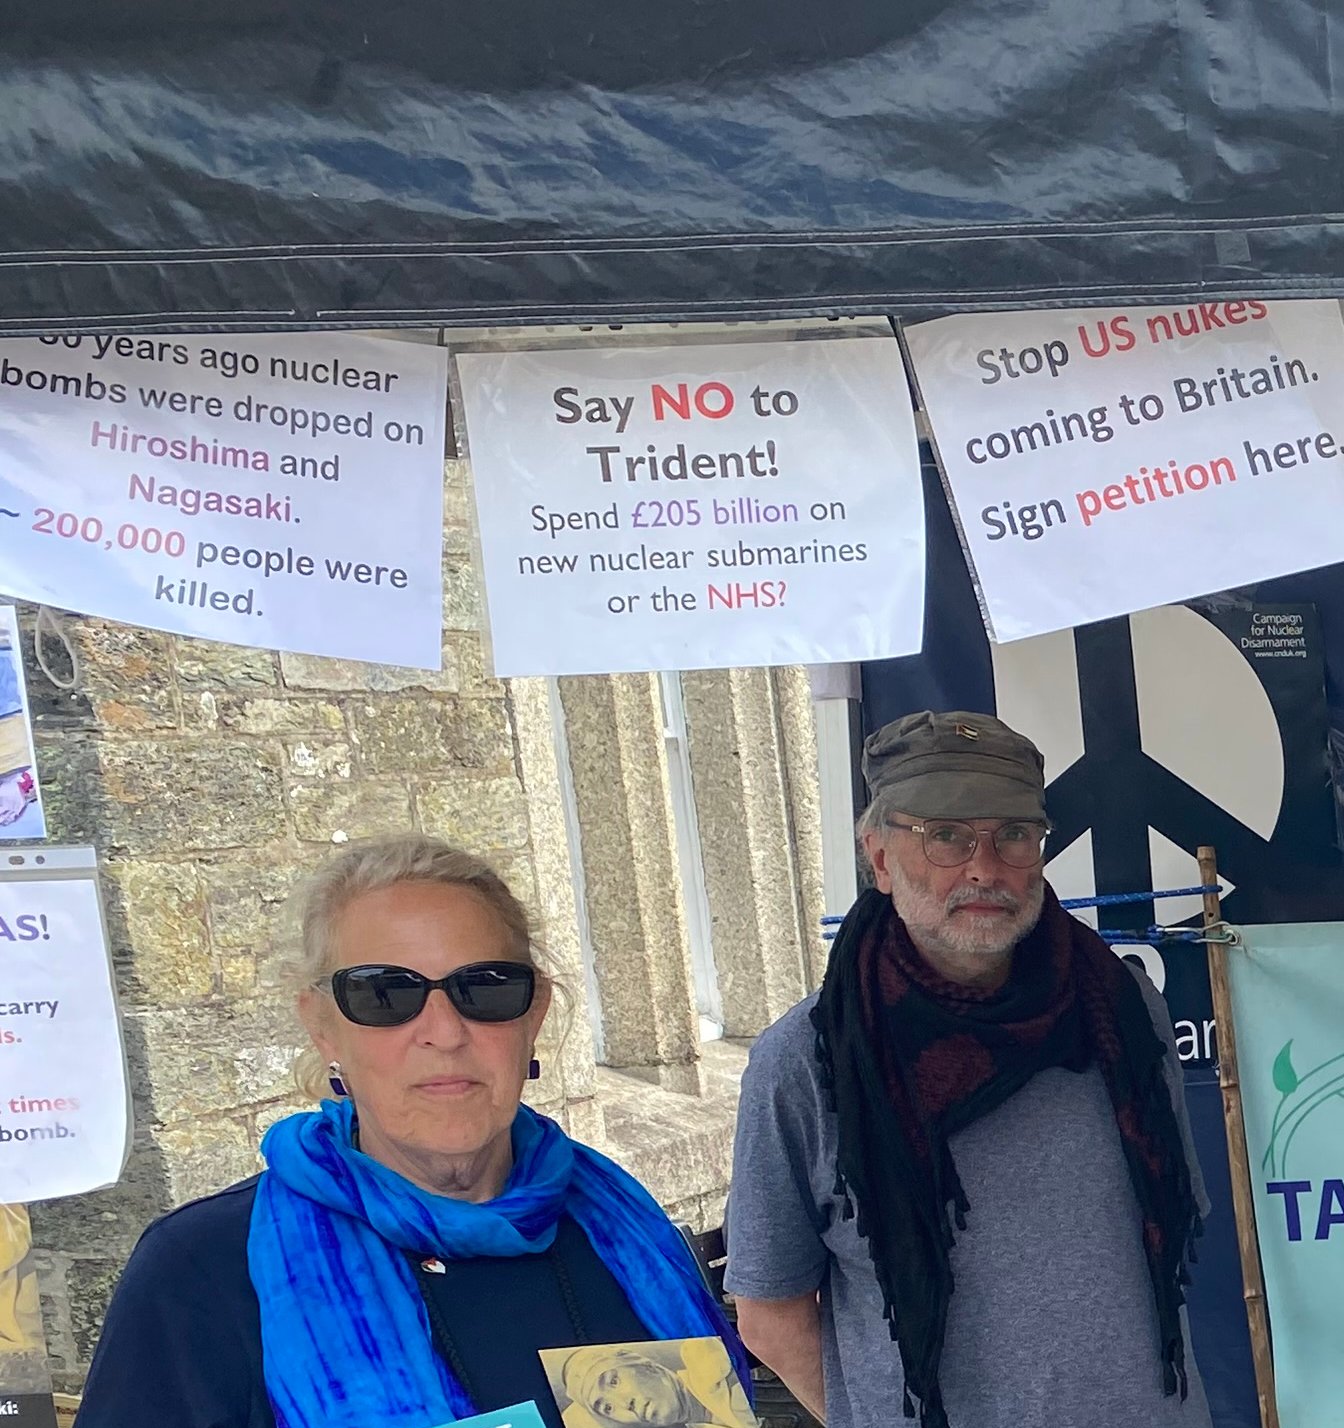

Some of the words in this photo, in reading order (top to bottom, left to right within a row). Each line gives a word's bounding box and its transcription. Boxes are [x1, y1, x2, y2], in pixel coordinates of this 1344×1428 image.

[93, 336, 189, 366] years
[199, 348, 260, 379] ago
[270, 356, 399, 393] nuclear
[976, 339, 1069, 385] Stop
[1077, 315, 1136, 358] US
[1146, 300, 1268, 343] nukes
[0, 357, 127, 404] bombs
[138, 387, 223, 418] were
[233, 394, 373, 439] dropped
[383, 421, 424, 446] on
[553, 386, 635, 434] Say
[651, 381, 735, 421] NO
[749, 384, 799, 418] to
[966, 405, 1114, 465] coming
[1118, 394, 1164, 426] to
[1173, 354, 1319, 414] Britain.
[91, 420, 270, 473] Hiroshima
[279, 454, 340, 482] and
[585, 439, 779, 483] Trident!
[128, 473, 301, 524] Nagasaki.
[531, 502, 620, 540] Spend
[631, 499, 702, 529] £205
[712, 496, 799, 525] billion
[810, 501, 846, 521] on
[981, 499, 1067, 541] Sign
[1075, 457, 1237, 527] petition
[31, 507, 186, 560] 200,000
[196, 541, 315, 578] people
[324, 558, 408, 589] were
[518, 554, 579, 575] new
[589, 543, 695, 573] nuclear
[707, 540, 868, 568] submarines
[154, 574, 264, 617] killed.
[607, 595, 640, 614] or
[650, 585, 697, 613] the
[707, 580, 787, 610] NHS?
[1252, 612, 1303, 626] Campaign
[1240, 637, 1306, 649] Disarmament
[1251, 625, 1265, 636] for
[1267, 624, 1304, 636] Nuclear
[9, 1096, 81, 1113] times
